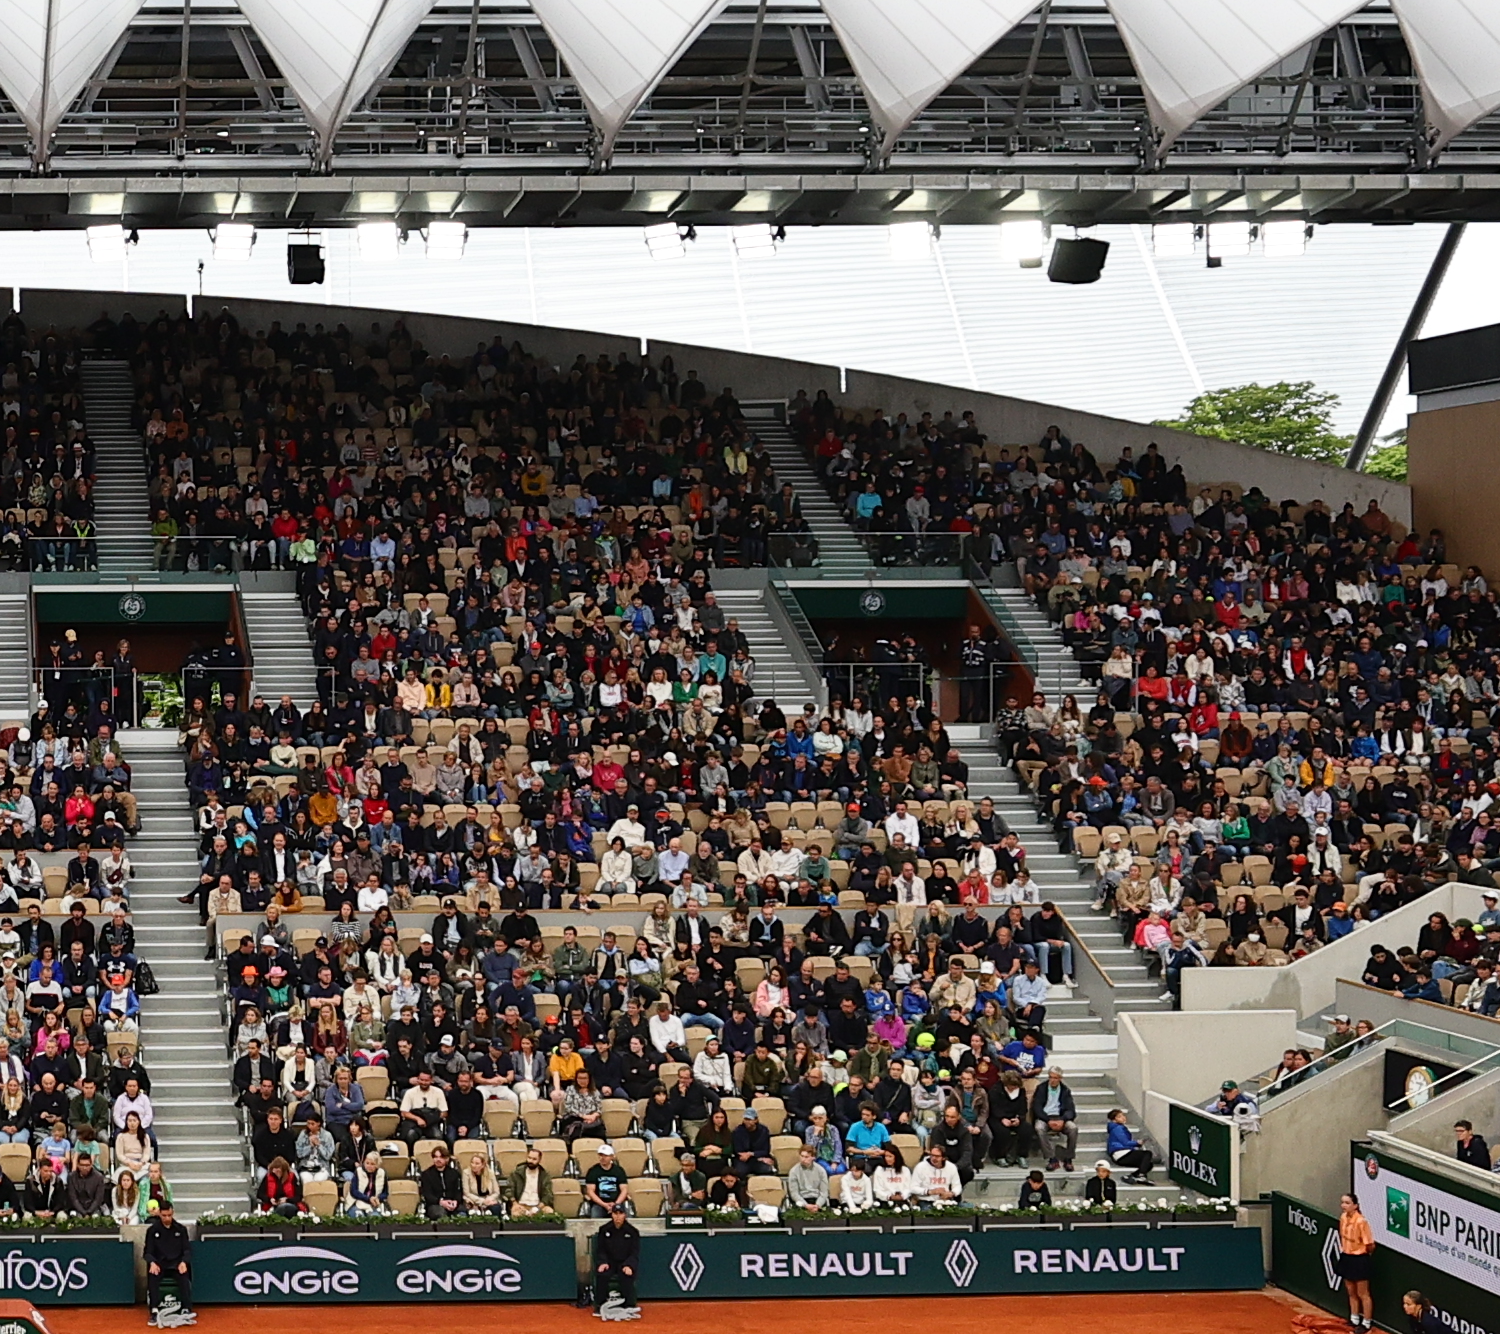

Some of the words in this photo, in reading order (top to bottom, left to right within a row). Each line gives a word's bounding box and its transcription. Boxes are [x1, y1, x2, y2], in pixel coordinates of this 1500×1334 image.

[1173, 1151, 1217, 1187] ROLEX
[1288, 1204, 1318, 1235] Infosys
[1416, 1200, 1451, 1236] BNP
[740, 1251, 913, 1277] RENAULT
[1014, 1246, 1185, 1273] RENAULT
